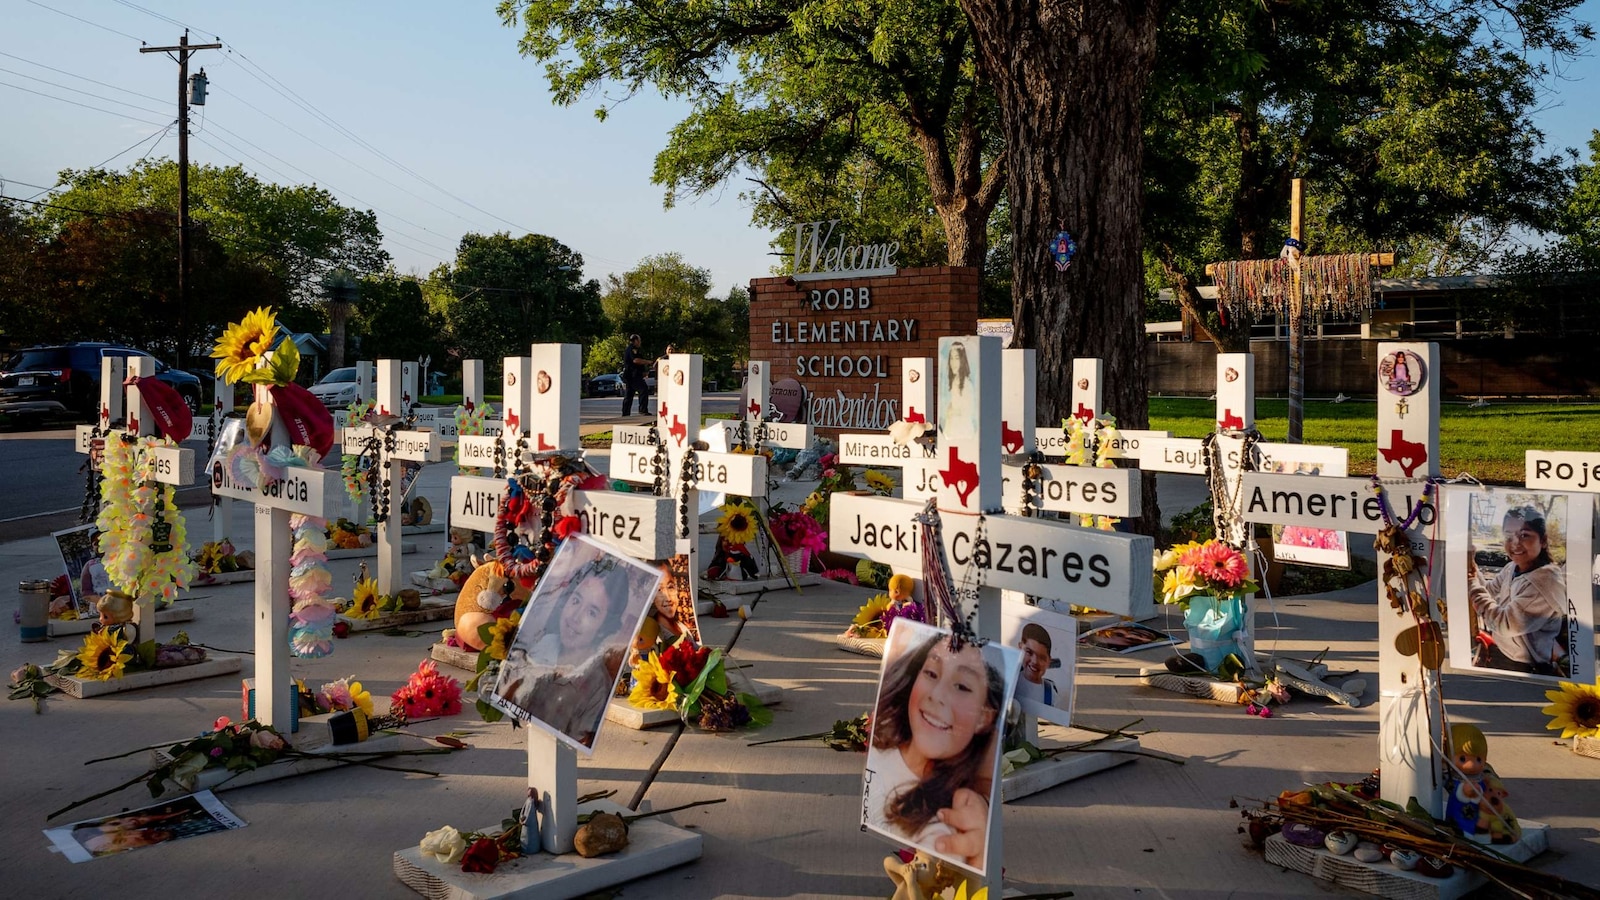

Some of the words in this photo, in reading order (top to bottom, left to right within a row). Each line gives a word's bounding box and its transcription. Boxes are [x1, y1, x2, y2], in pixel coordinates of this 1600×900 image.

[793, 219, 900, 274] Welcome
[811, 287, 871, 311] ROBB
[772, 319, 915, 343] ELEMENTARY
[796, 355, 887, 378] SCHOOL
[771, 387, 798, 397] STRONG
[391, 437, 430, 455] driguez
[845, 441, 911, 459] Miranda
[1034, 436, 1065, 451] ayce
[1164, 447, 1206, 468] Layl
[693, 459, 728, 484] ata
[1036, 475, 1118, 504] lores
[462, 490, 502, 517] Alit
[574, 506, 642, 542] mirez
[1247, 485, 1381, 522] Amerie
[1396, 494, 1437, 526] Jo
[850, 513, 919, 554] Jacki
[951, 530, 1111, 588] Cazares
[1568, 598, 1580, 676] AMERIE
[860, 768, 877, 833] JACKIE
